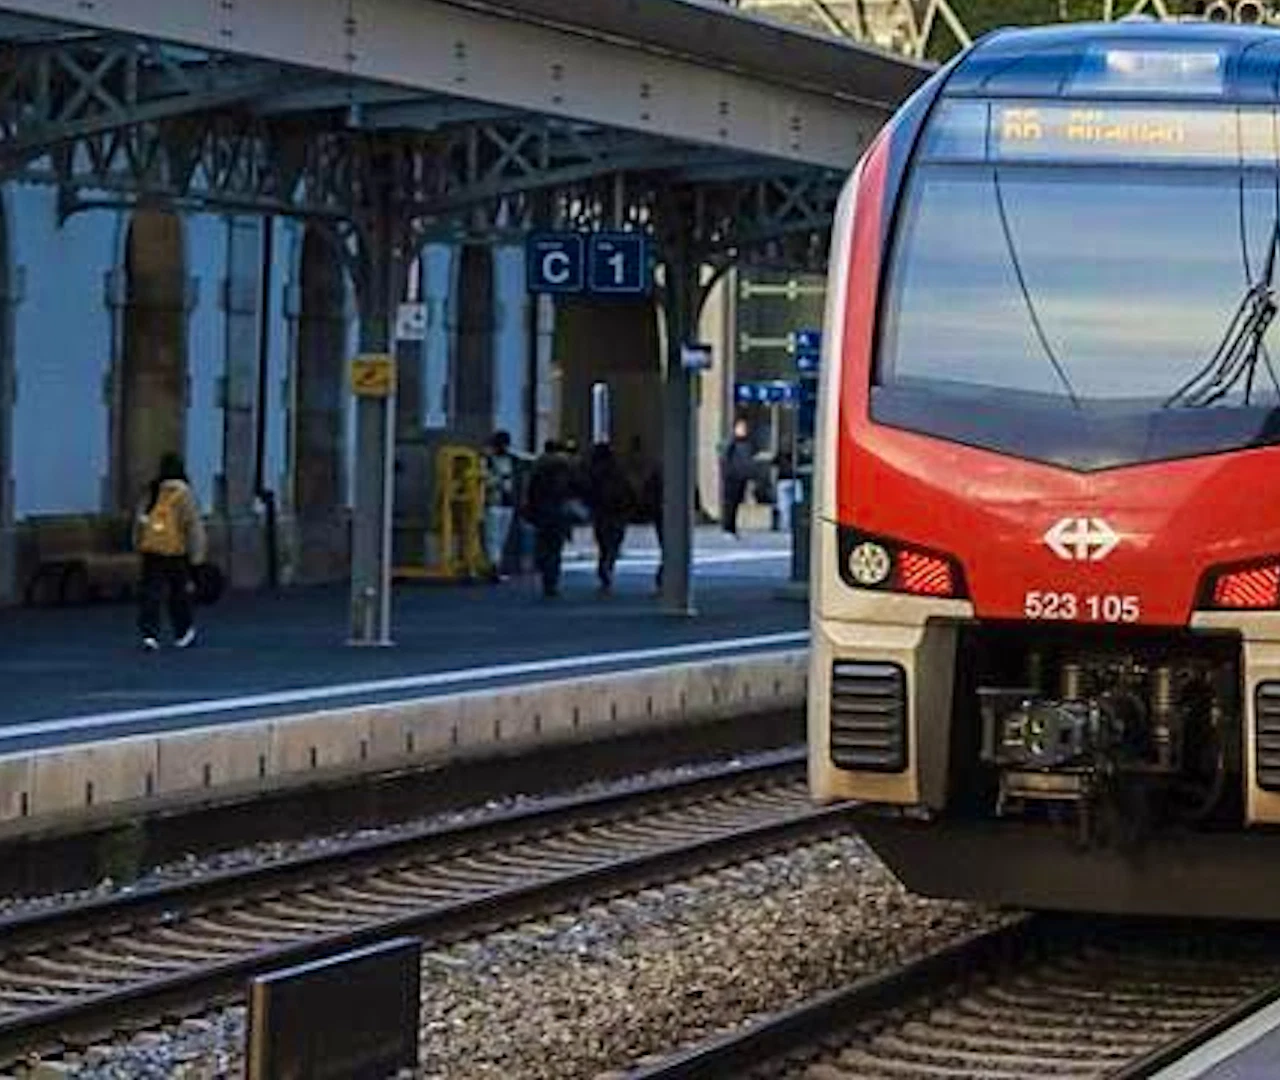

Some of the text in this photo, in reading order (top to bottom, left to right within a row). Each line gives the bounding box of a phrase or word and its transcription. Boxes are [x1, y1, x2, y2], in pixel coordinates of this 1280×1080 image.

[543, 251, 570, 284] C
[608, 252, 624, 284] 1
[1025, 591, 1140, 622] 523 105
